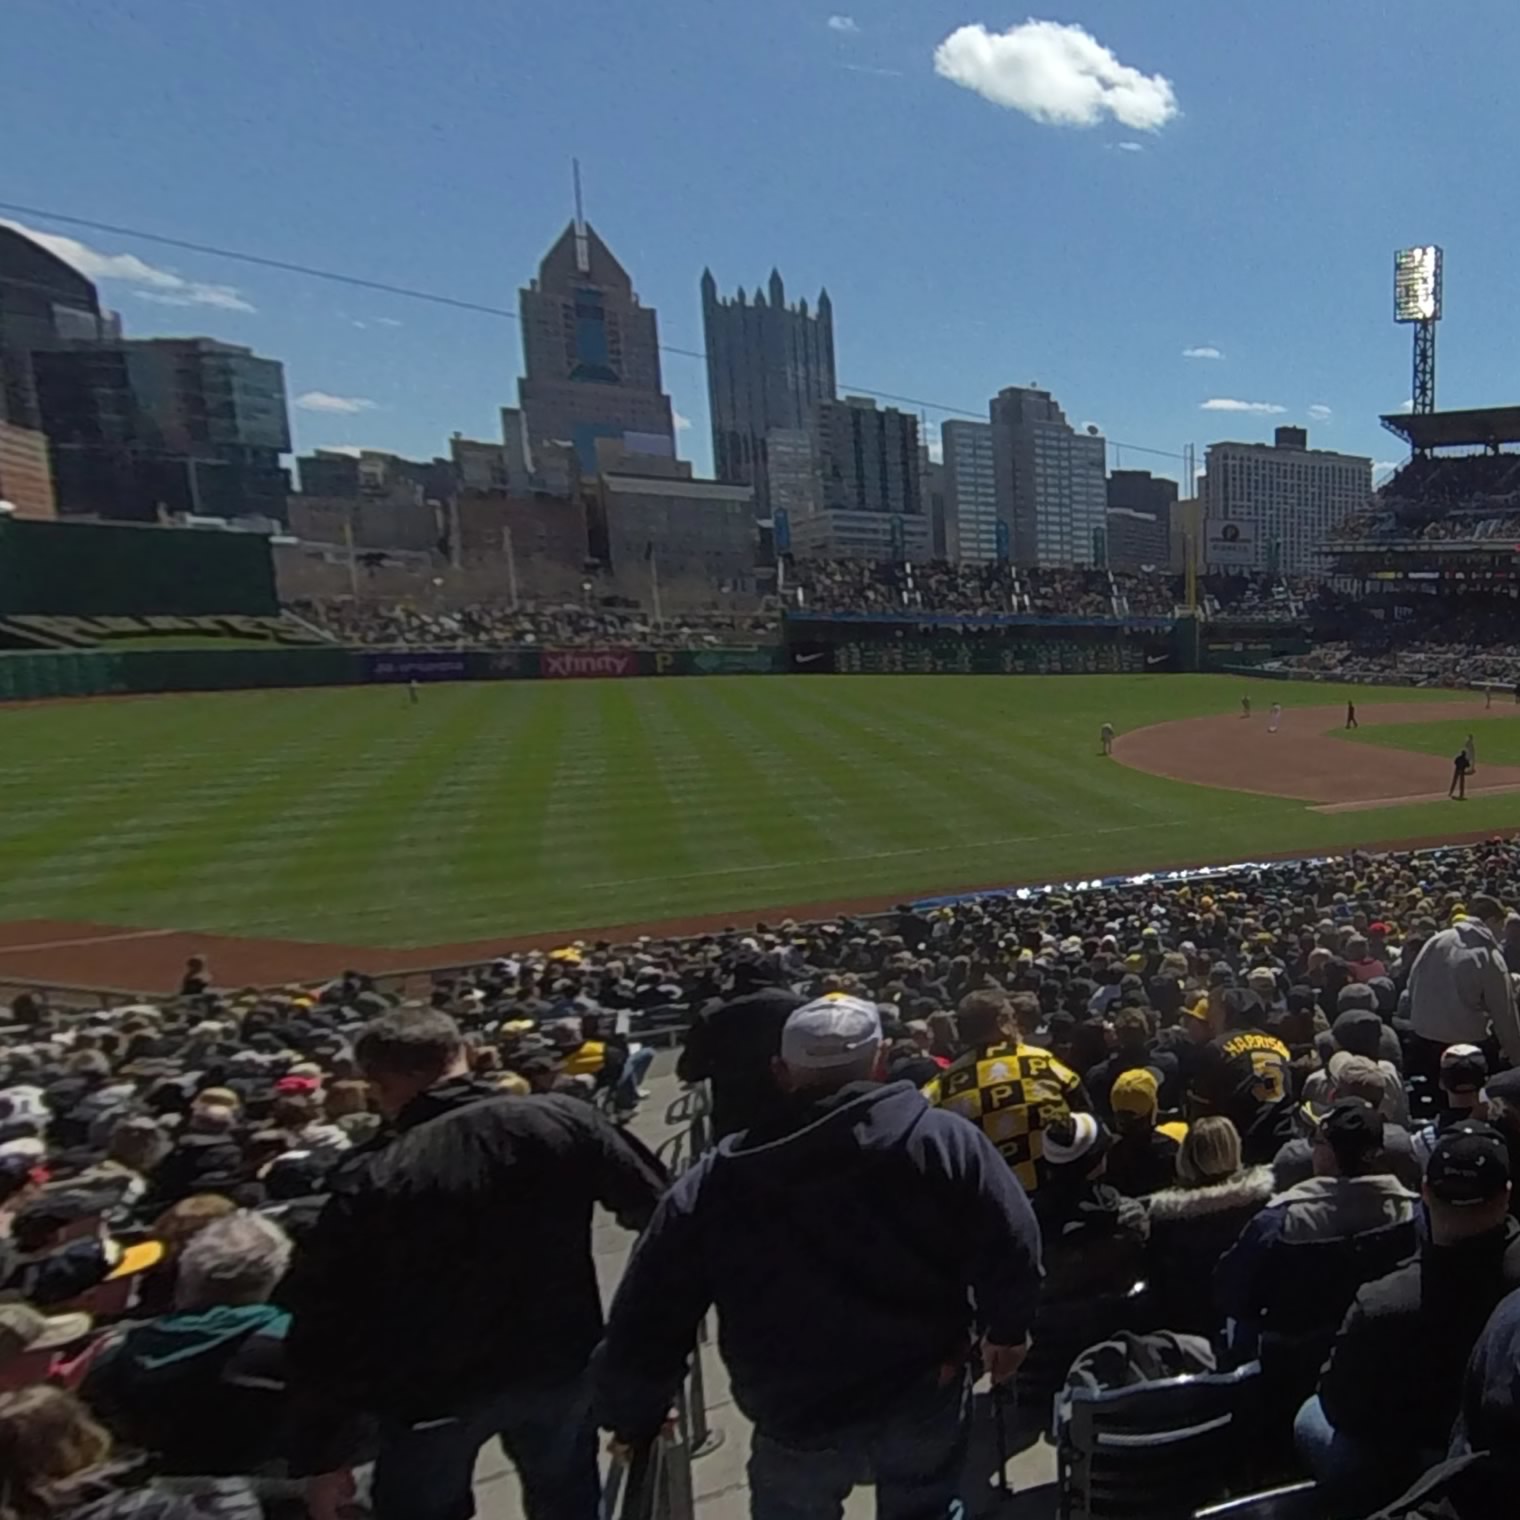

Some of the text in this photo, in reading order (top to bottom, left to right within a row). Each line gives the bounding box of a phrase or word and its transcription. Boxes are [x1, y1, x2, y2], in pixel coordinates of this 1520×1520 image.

[546, 654, 628, 676] xfinity
[655, 653, 674, 674] P
[1028, 1058, 1047, 1075] P
[1251, 1052, 1286, 1103] 5
[948, 1072, 970, 1094] P
[990, 1086, 1013, 1109] P
